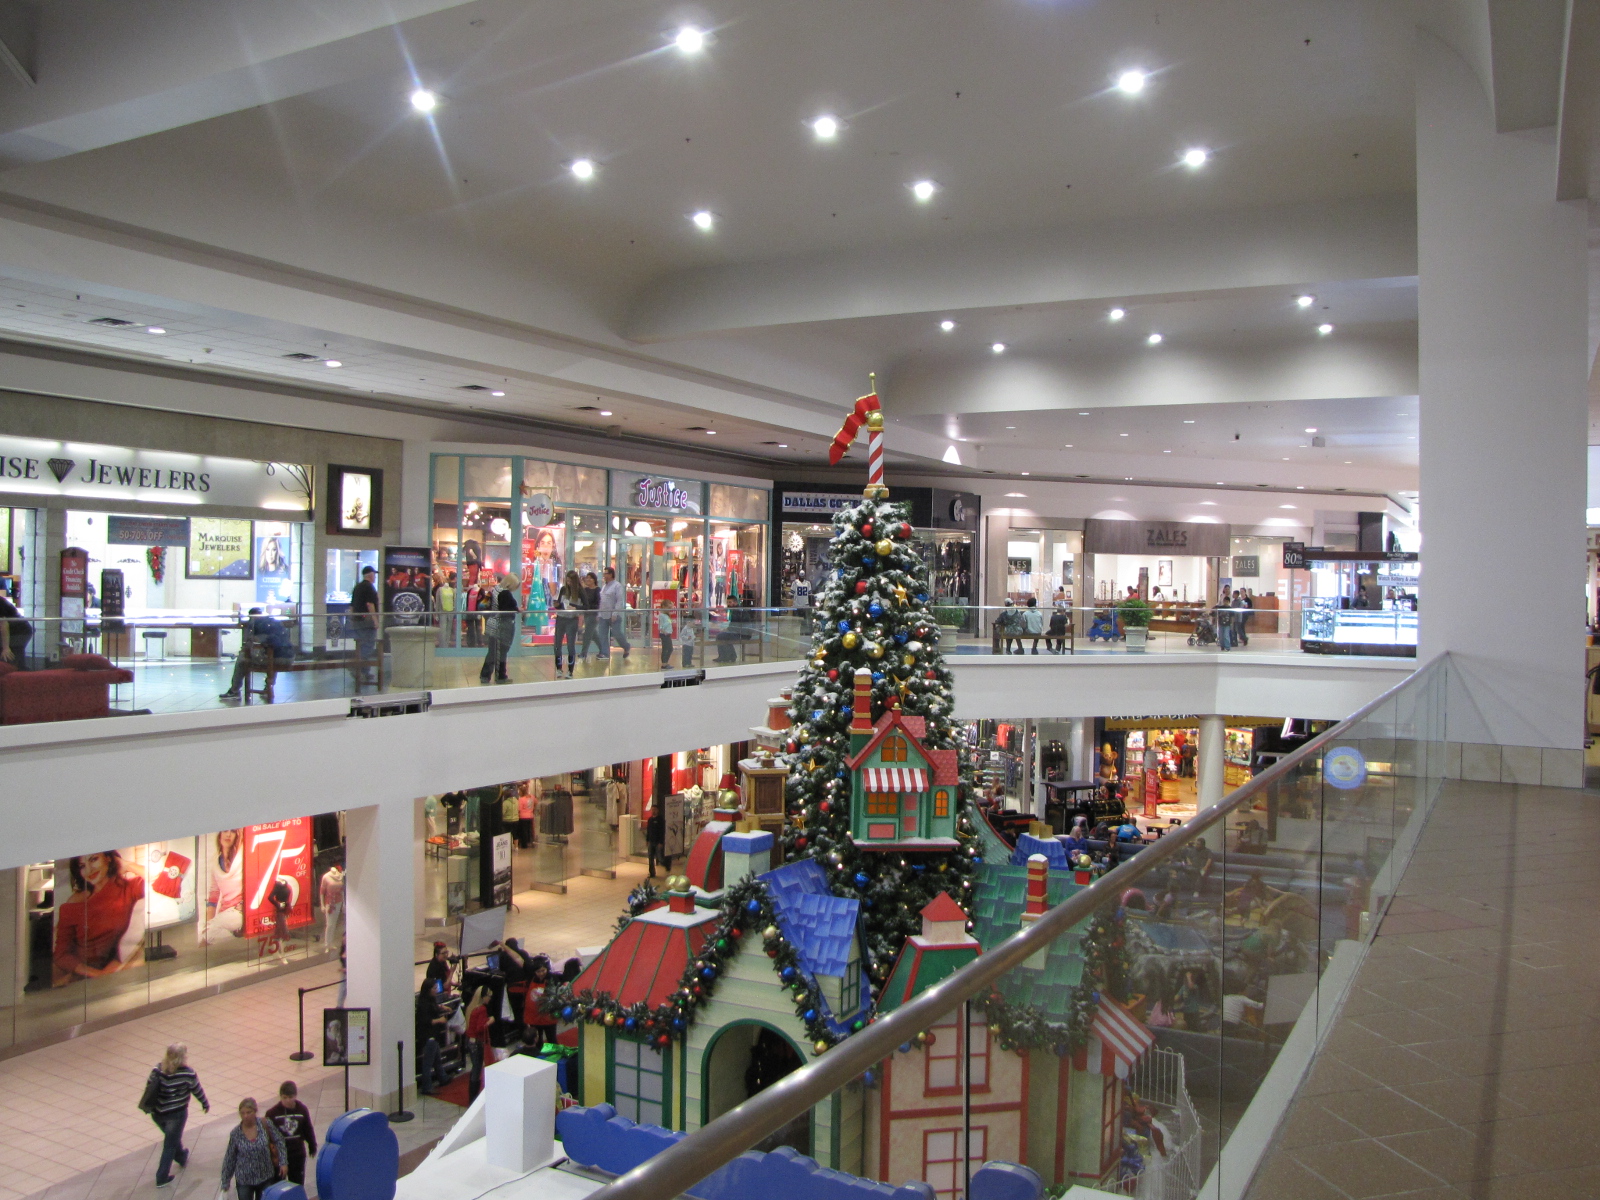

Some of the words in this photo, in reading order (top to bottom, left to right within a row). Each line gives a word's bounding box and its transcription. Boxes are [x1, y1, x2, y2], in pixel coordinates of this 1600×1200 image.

[81, 458, 211, 493] JEWELERS
[638, 477, 688, 509] Justice
[783, 496, 827, 508] DALLAS
[529, 504, 550, 517] Justice
[148, 531, 164, 541] OFF
[198, 532, 243, 544] MARQUISE
[1147, 529, 1188, 543] ZALES
[198, 542, 241, 552] JEWELERS
[1235, 559, 1255, 569] ZALES
[1284, 552, 1297, 565] 80
[796, 586, 808, 597] 82
[252, 824, 262, 832] ON
[262, 822, 280, 830] SALE
[281, 820, 292, 828] UP
[292, 818, 302, 826] TO
[295, 870, 307, 878] OFF
[257, 935, 280, 957] 75
